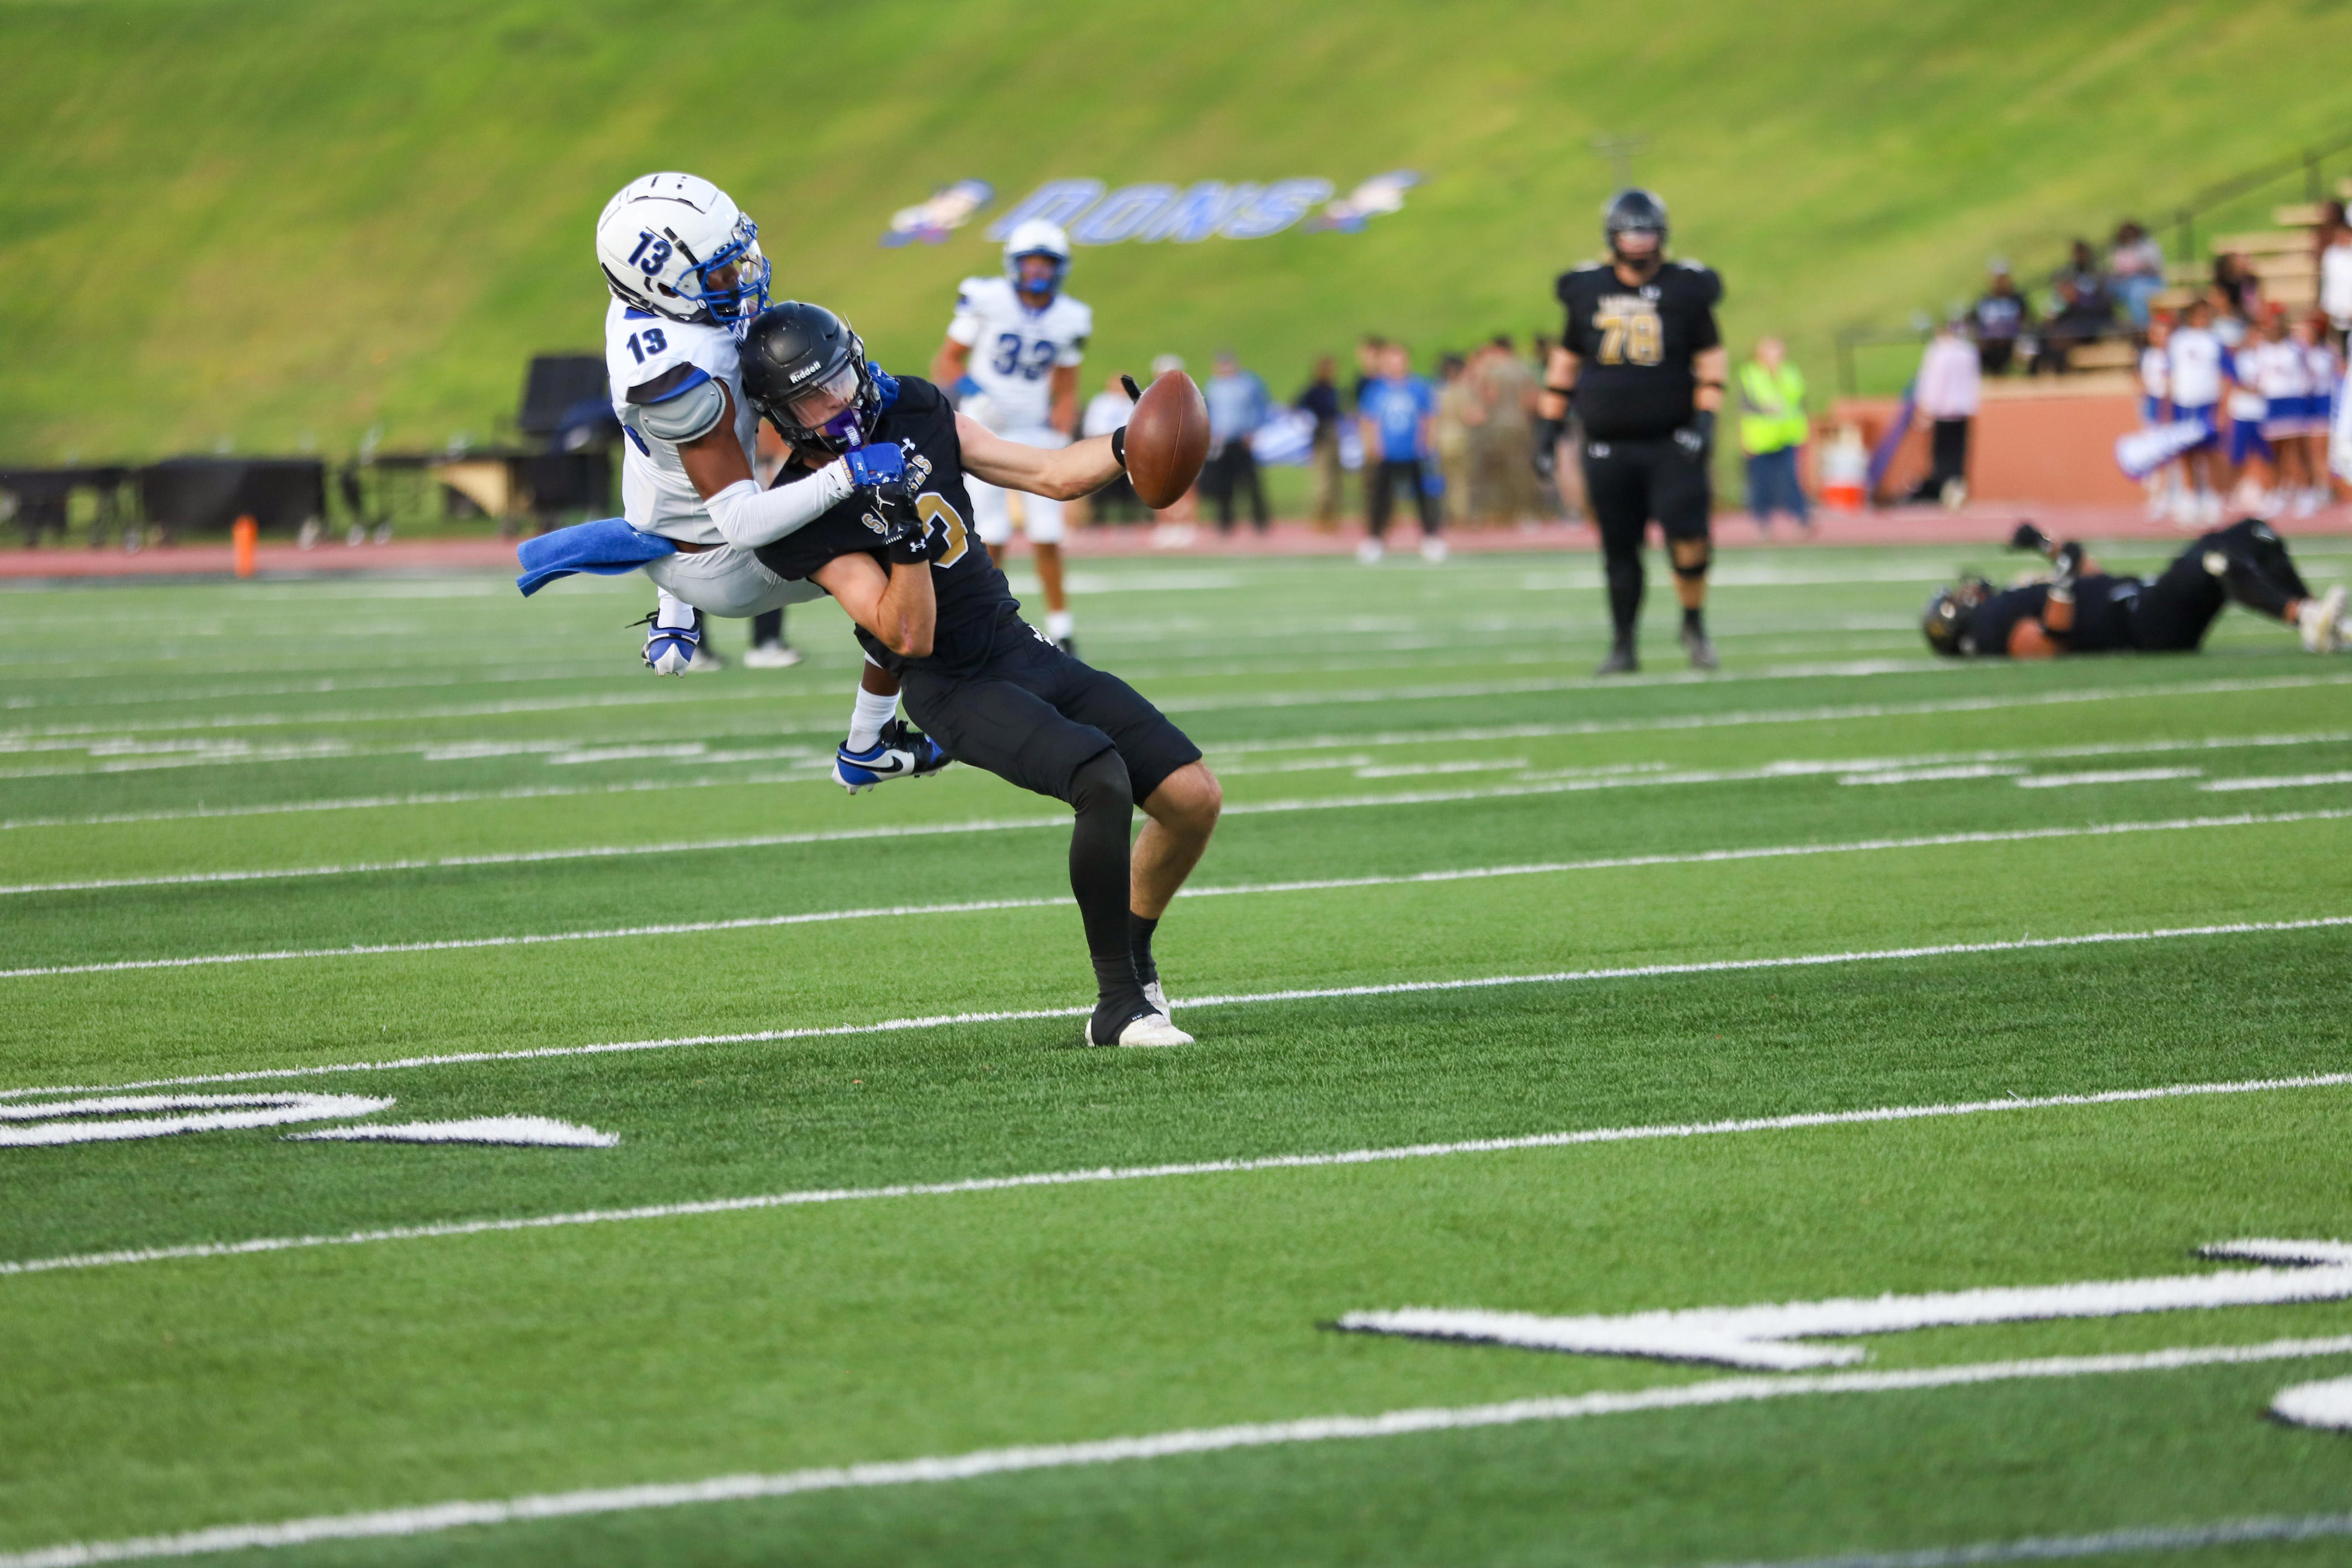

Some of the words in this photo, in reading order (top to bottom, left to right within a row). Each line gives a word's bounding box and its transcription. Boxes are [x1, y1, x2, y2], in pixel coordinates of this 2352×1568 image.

[627, 231, 673, 276] 13
[626, 328, 668, 366] 13
[1592, 313, 1665, 366] 78
[790, 361, 821, 384] Riddell
